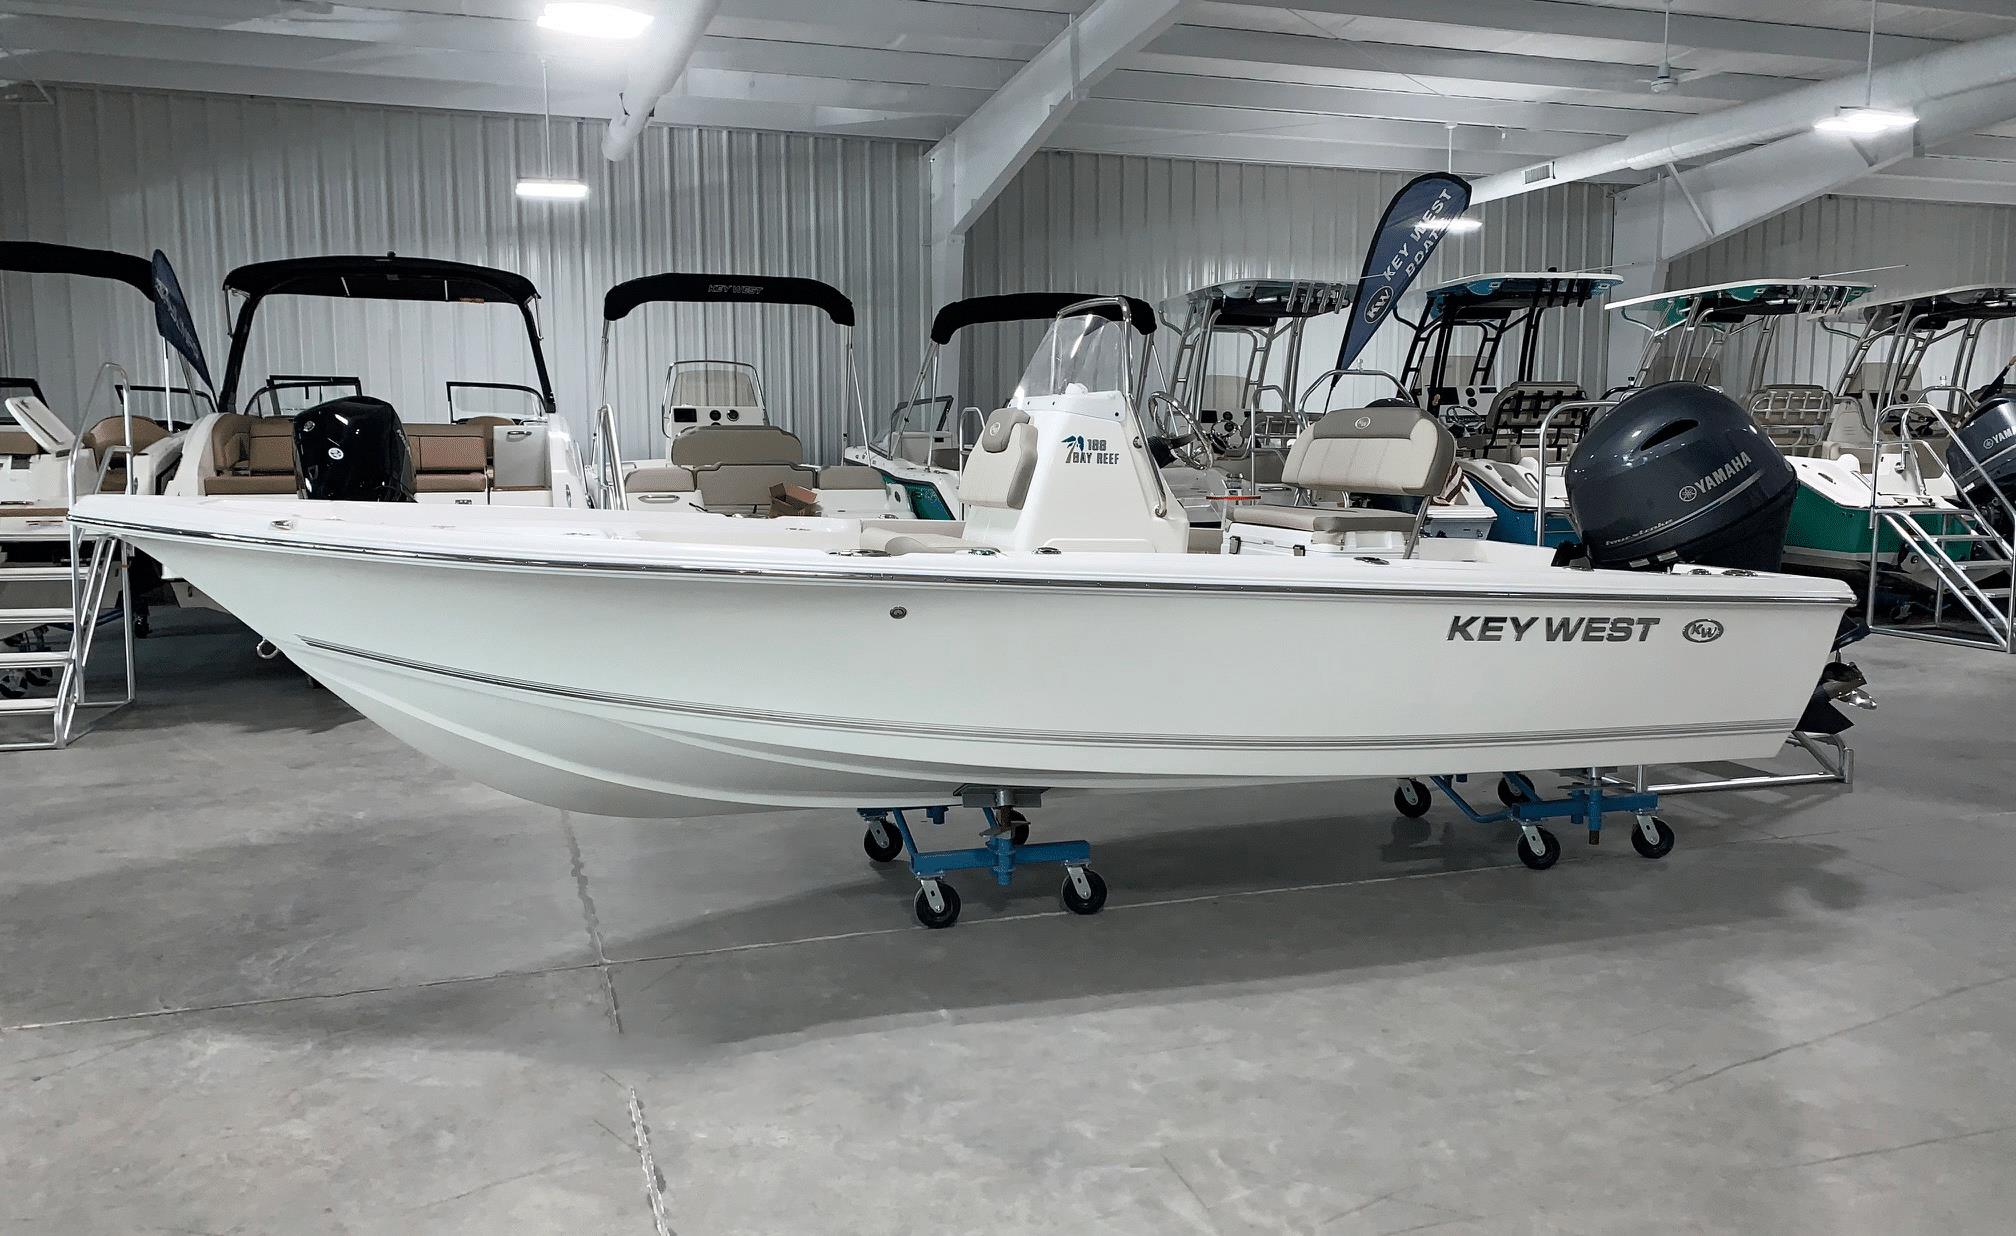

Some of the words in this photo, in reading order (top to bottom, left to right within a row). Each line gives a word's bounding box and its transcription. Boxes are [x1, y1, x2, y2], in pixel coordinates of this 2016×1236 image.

[1383, 243, 1408, 281] KEY
[1410, 188, 1451, 242] WEST
[1405, 218, 1447, 277] BOAT
[708, 284, 732, 293] KEY
[1366, 288, 1391, 319] KW
[1073, 452, 1092, 463] BAY
[1096, 452, 1120, 464] REEF
[1087, 439, 1107, 451] 188
[1695, 451, 1752, 494] YAMAHA
[1446, 615, 1540, 642] KEY
[1545, 616, 1661, 642] WEST
